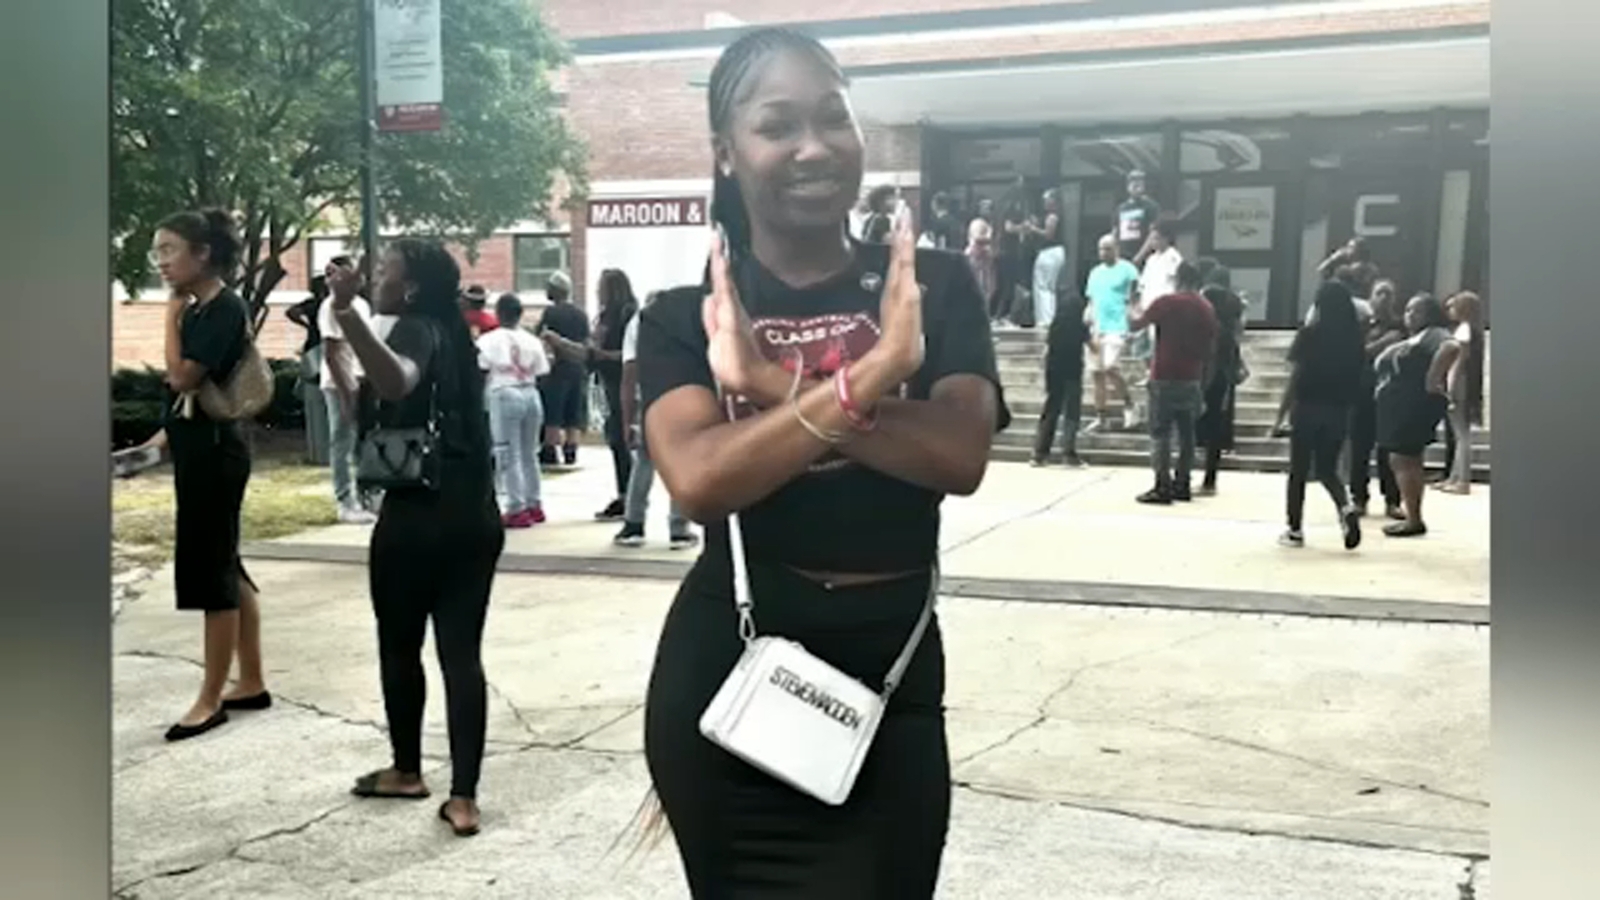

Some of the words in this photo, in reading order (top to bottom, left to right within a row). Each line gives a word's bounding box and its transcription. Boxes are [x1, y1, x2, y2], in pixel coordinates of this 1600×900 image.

[591, 202, 680, 225] MAROON
[687, 201, 701, 223] &
[765, 328, 827, 345] CLASS
[829, 320, 859, 336] OF
